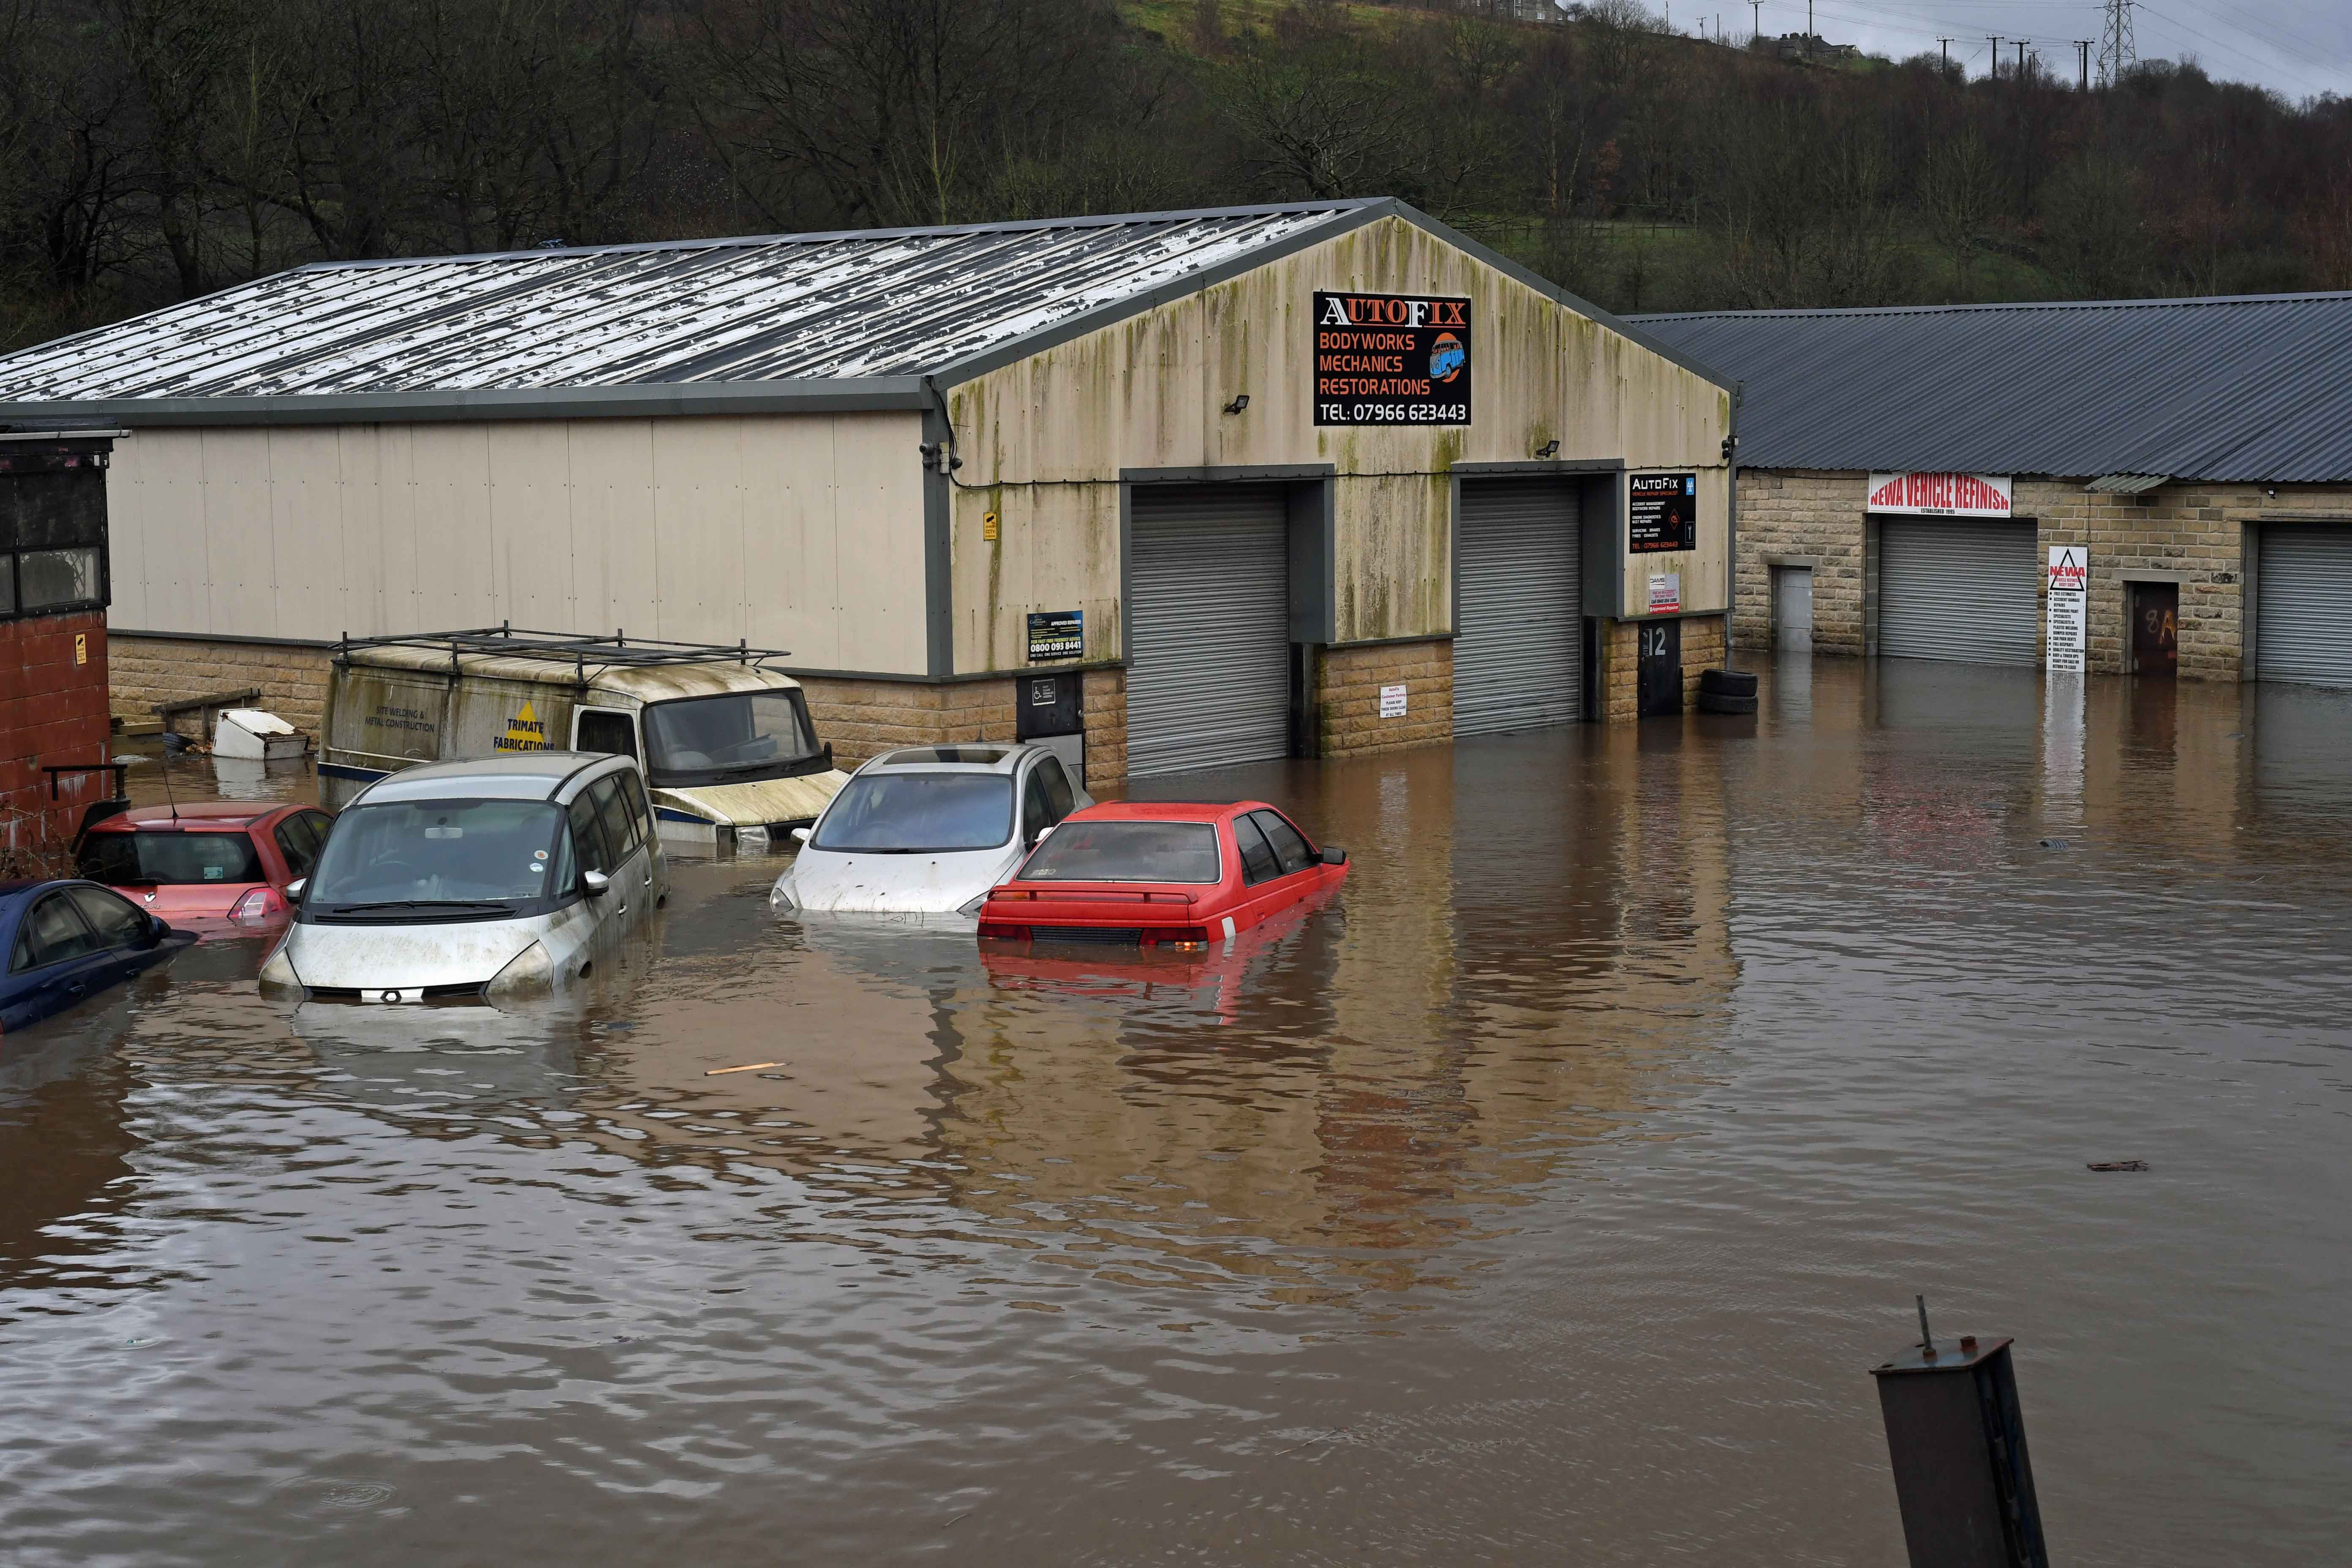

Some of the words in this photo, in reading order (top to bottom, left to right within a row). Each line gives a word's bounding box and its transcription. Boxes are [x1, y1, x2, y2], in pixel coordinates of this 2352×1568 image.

[1320, 332, 1415, 351] BODYWORKS
[1320, 355, 1402, 372] MECHANICS
[1320, 378, 1430, 395] RESTORATIONS
[1320, 404, 1350, 421] TEL:
[1354, 404, 1405, 421] 07966
[1409, 404, 1466, 421] 623443
[1870, 476, 1903, 506] NEWA
[1906, 472, 1952, 508] VEHICLE
[1956, 473, 2009, 510] REFINISH
[2050, 566, 2085, 577] NEWA
[1031, 643, 1050, 652] 0800
[1051, 642, 1064, 651] 093
[1065, 641, 1081, 650] 8441
[1646, 627, 1666, 656] 12
[376, 706, 388, 715] SITE
[389, 707, 418, 719] WELDING
[419, 710, 425, 719] &
[365, 716, 384, 727] METAL
[386, 719, 435, 733] CONSTRUCTION
[507, 719, 544, 734] TRIMATE
[493, 736, 555, 751] FABRICATIONS
